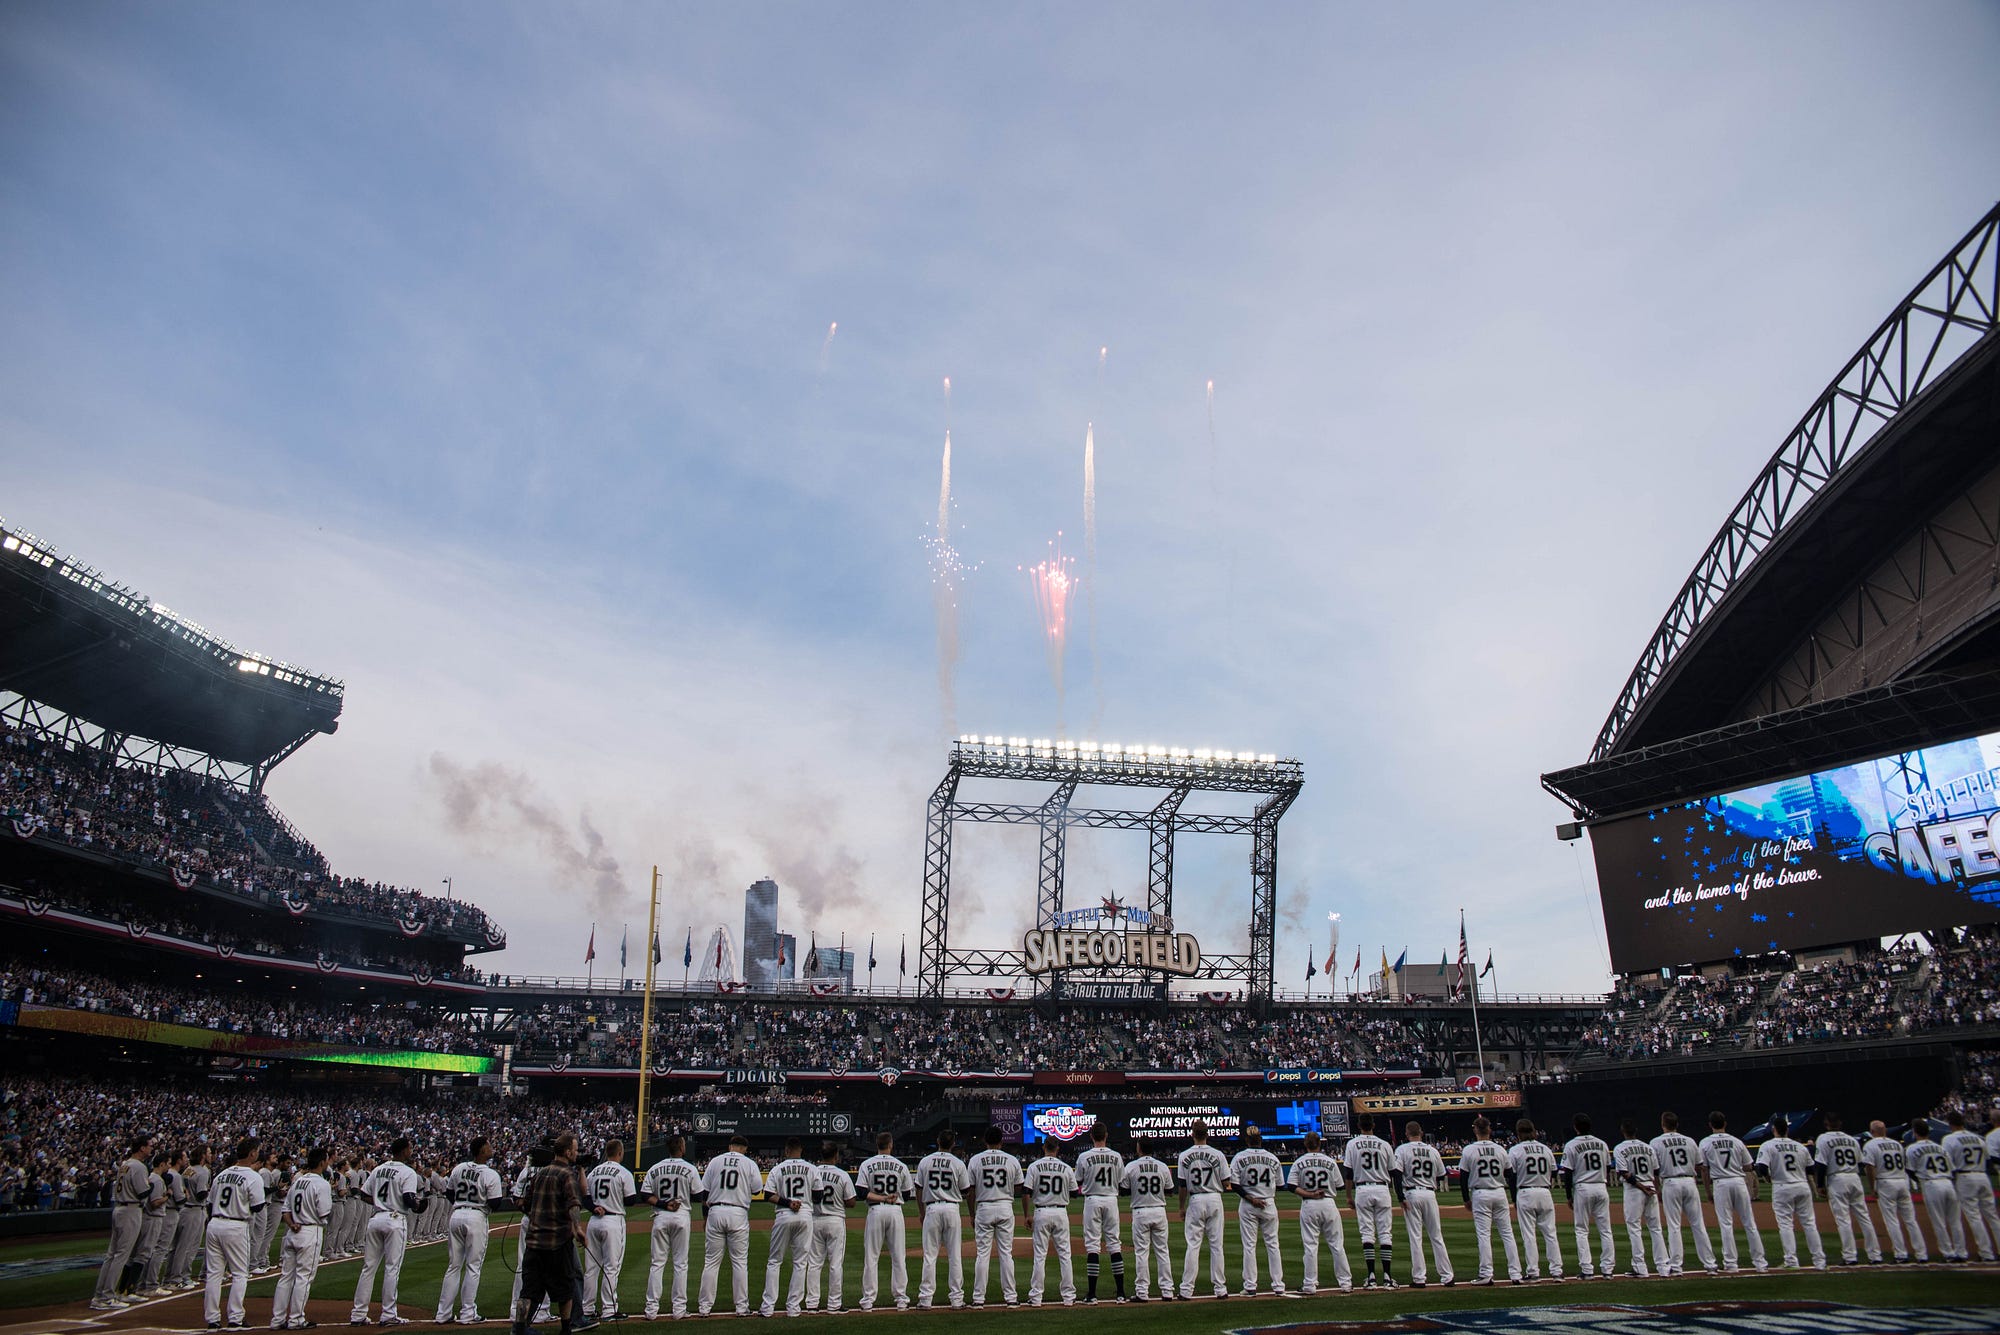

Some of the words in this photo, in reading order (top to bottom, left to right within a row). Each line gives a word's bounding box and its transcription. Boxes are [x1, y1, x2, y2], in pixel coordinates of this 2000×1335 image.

[1742, 843, 1757, 868] of
[1761, 840, 1781, 858] the
[1784, 836, 1813, 862] free,
[1644, 889, 1669, 909] and
[1672, 887, 1692, 904] the
[1695, 883, 1730, 900] home
[1734, 874, 1750, 900] of
[1753, 872, 1774, 890] the
[1777, 868, 1822, 886] brave.
[1052, 907, 1100, 929] SEATTLE
[1127, 906, 1175, 931] MARINERS
[1024, 929, 1122, 976] SAFECO
[1126, 933, 1201, 977] FIELD
[1074, 983, 1098, 999] TRUE
[1100, 985, 1113, 999] TO
[1114, 985, 1130, 999] THE
[1132, 983, 1156, 999] BLUE
[726, 1069, 787, 1083] EDGARS
[883, 1074, 896, 1084] 42
[1066, 1072, 1093, 1084] xfinity
[1280, 1072, 1301, 1081] pepsi
[1320, 1072, 1341, 1081] pepsi
[1150, 1106, 1187, 1115] NATIONAL
[1188, 1106, 1218, 1114] ANTHEM
[1323, 1105, 1345, 1115] BUILT
[1364, 1098, 1418, 1109] THE
[1034, 1115, 1070, 1127] OPENING
[1071, 1114, 1097, 1126] NIGHT
[1129, 1117, 1172, 1128] CAPTAIN
[1324, 1124, 1347, 1132] TOUGH
[1130, 1130, 1158, 1138] UNITED
[1159, 1129, 1186, 1138] STATES
[1216, 1129, 1240, 1137] CORPS
[1356, 1141, 1382, 1150] CISHEK
[1523, 1145, 1544, 1154] MILEY
[1575, 1142, 1604, 1153] IWAKUMA
[1662, 1137, 1687, 1148] KARNS
[1711, 1140, 1734, 1150] SMITH
[1775, 1144, 1798, 1153] SUCRE
[1183, 1151, 1221, 1169] MONTGOMERY
[1413, 1148, 1430, 1158] COOK
[1478, 1147, 1495, 1157] LIND
[1669, 1148, 1688, 1167] 13
[1720, 1151, 1731, 1169] 7
[1834, 1149, 1857, 1166] 89
[1963, 1147, 1983, 1165] 27
[723, 1157, 740, 1168] LEE
[867, 1161, 904, 1174] SCRIBNER
[932, 1158, 951, 1168] ZYCH
[980, 1156, 1008, 1167] BENOIT
[1036, 1163, 1067, 1173] VINCENT
[1087, 1155, 1118, 1167] FURBUSH
[1139, 1164, 1158, 1173] NUNO
[1239, 1155, 1280, 1174] HERNANDEZ
[1297, 1159, 1335, 1171] CLEVENGER
[1361, 1152, 1379, 1170] 31
[1411, 1160, 1433, 1178] 29
[1477, 1159, 1500, 1177] 26
[1525, 1156, 1547, 1175] 20
[1583, 1152, 1602, 1171] 18
[1632, 1156, 1648, 1175] 16
[1784, 1154, 1796, 1171] 2
[1883, 1153, 1905, 1171] 88
[1925, 1156, 1948, 1174] 43
[592, 1167, 620, 1178] SEAGER
[650, 1165, 692, 1178] GUTIERREZ
[781, 1165, 809, 1176] MARTIN
[983, 1169, 1007, 1188] 53
[1095, 1167, 1112, 1186] 41
[1190, 1167, 1213, 1186] 37
[1247, 1168, 1271, 1187] 34
[217, 1173, 246, 1187] SERVIS
[720, 1169, 739, 1190] 10
[785, 1177, 804, 1197] 12
[873, 1174, 898, 1193] 58
[928, 1170, 953, 1191] 55
[1039, 1175, 1063, 1195] 50
[1138, 1176, 1161, 1195] 38
[1305, 1170, 1329, 1189] 32
[377, 1181, 389, 1202] 4
[455, 1182, 479, 1203] 22
[594, 1178, 610, 1199] 15
[659, 1178, 678, 1199] 21
[220, 1187, 232, 1208] 9
[294, 1193, 302, 1214] 8
